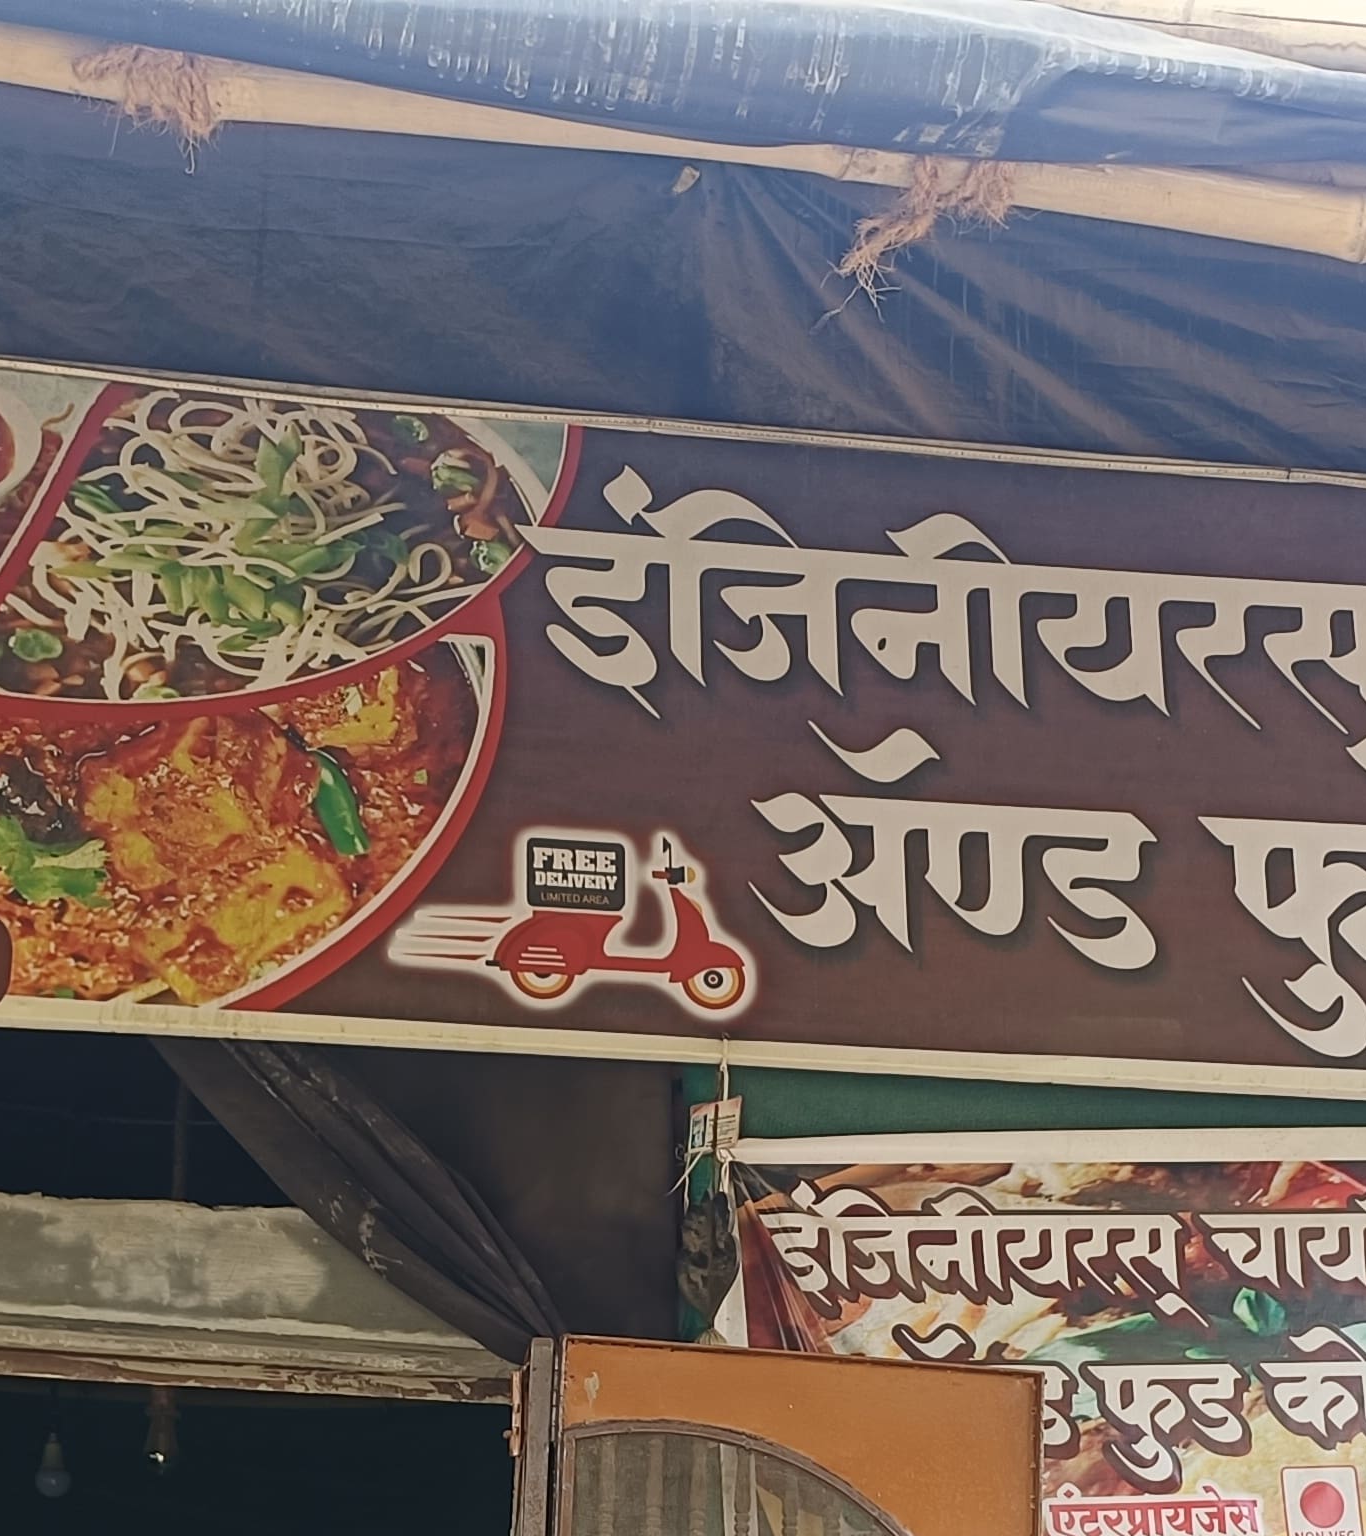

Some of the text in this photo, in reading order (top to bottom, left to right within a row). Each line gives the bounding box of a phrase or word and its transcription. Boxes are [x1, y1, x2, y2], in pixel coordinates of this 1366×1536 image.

[533, 847, 616, 873] FREE
[535, 871, 617, 890] DELIVERY
[541, 892, 609, 905] LIMITED AREA
[1085, 1364, 1248, 1482] फुड
